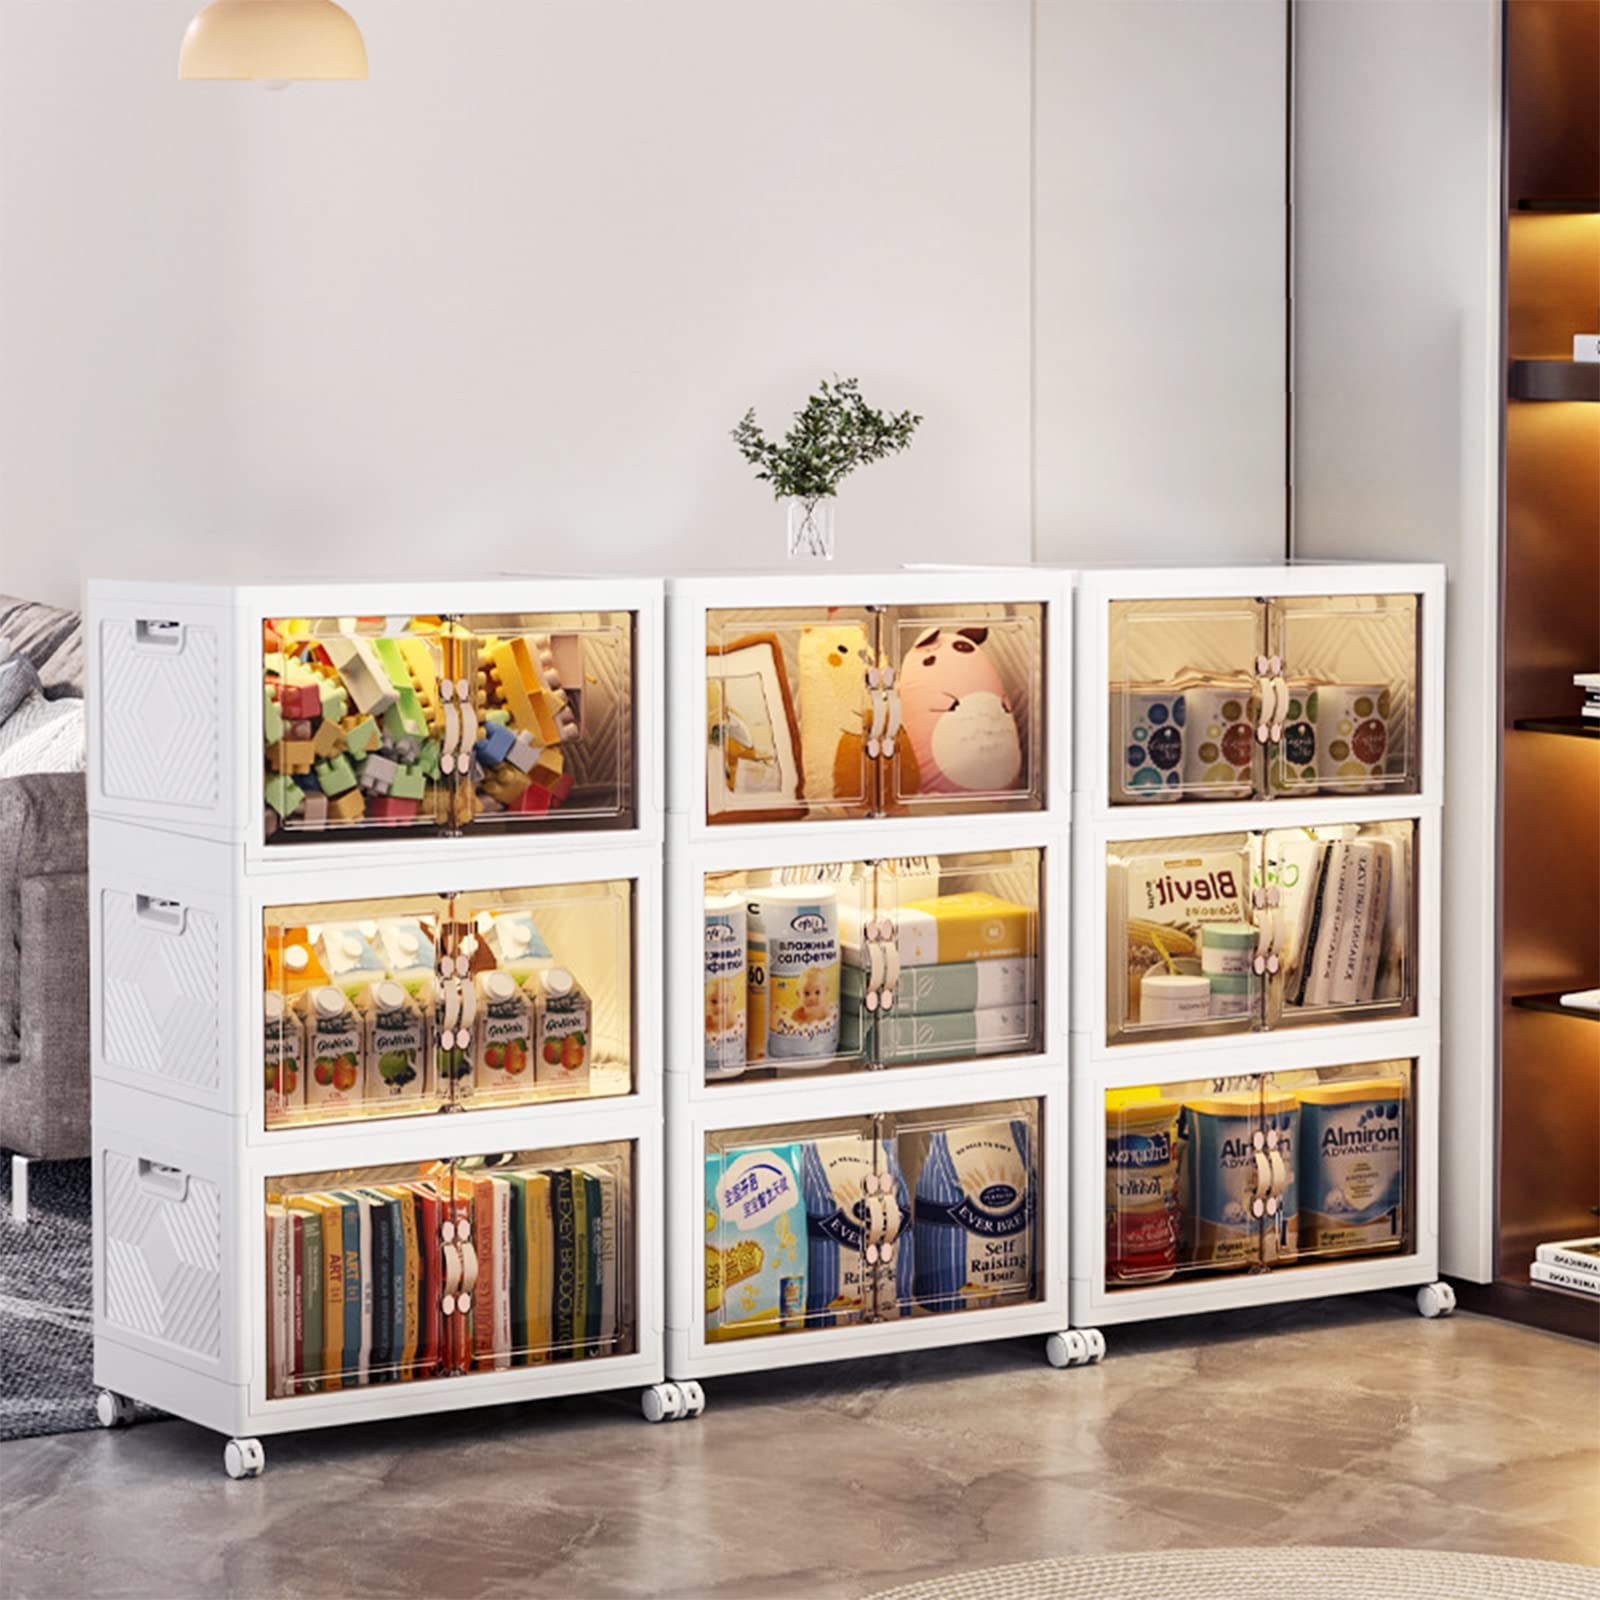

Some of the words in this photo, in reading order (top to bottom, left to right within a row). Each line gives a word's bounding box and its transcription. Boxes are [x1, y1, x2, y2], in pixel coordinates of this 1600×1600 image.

[1322, 1124, 1399, 1148] Almirón
[985, 1239, 1016, 1256] Self
[329, 1254, 342, 1282] ART
[345, 1250, 359, 1281] ART
[971, 1252, 1027, 1274] Raising
